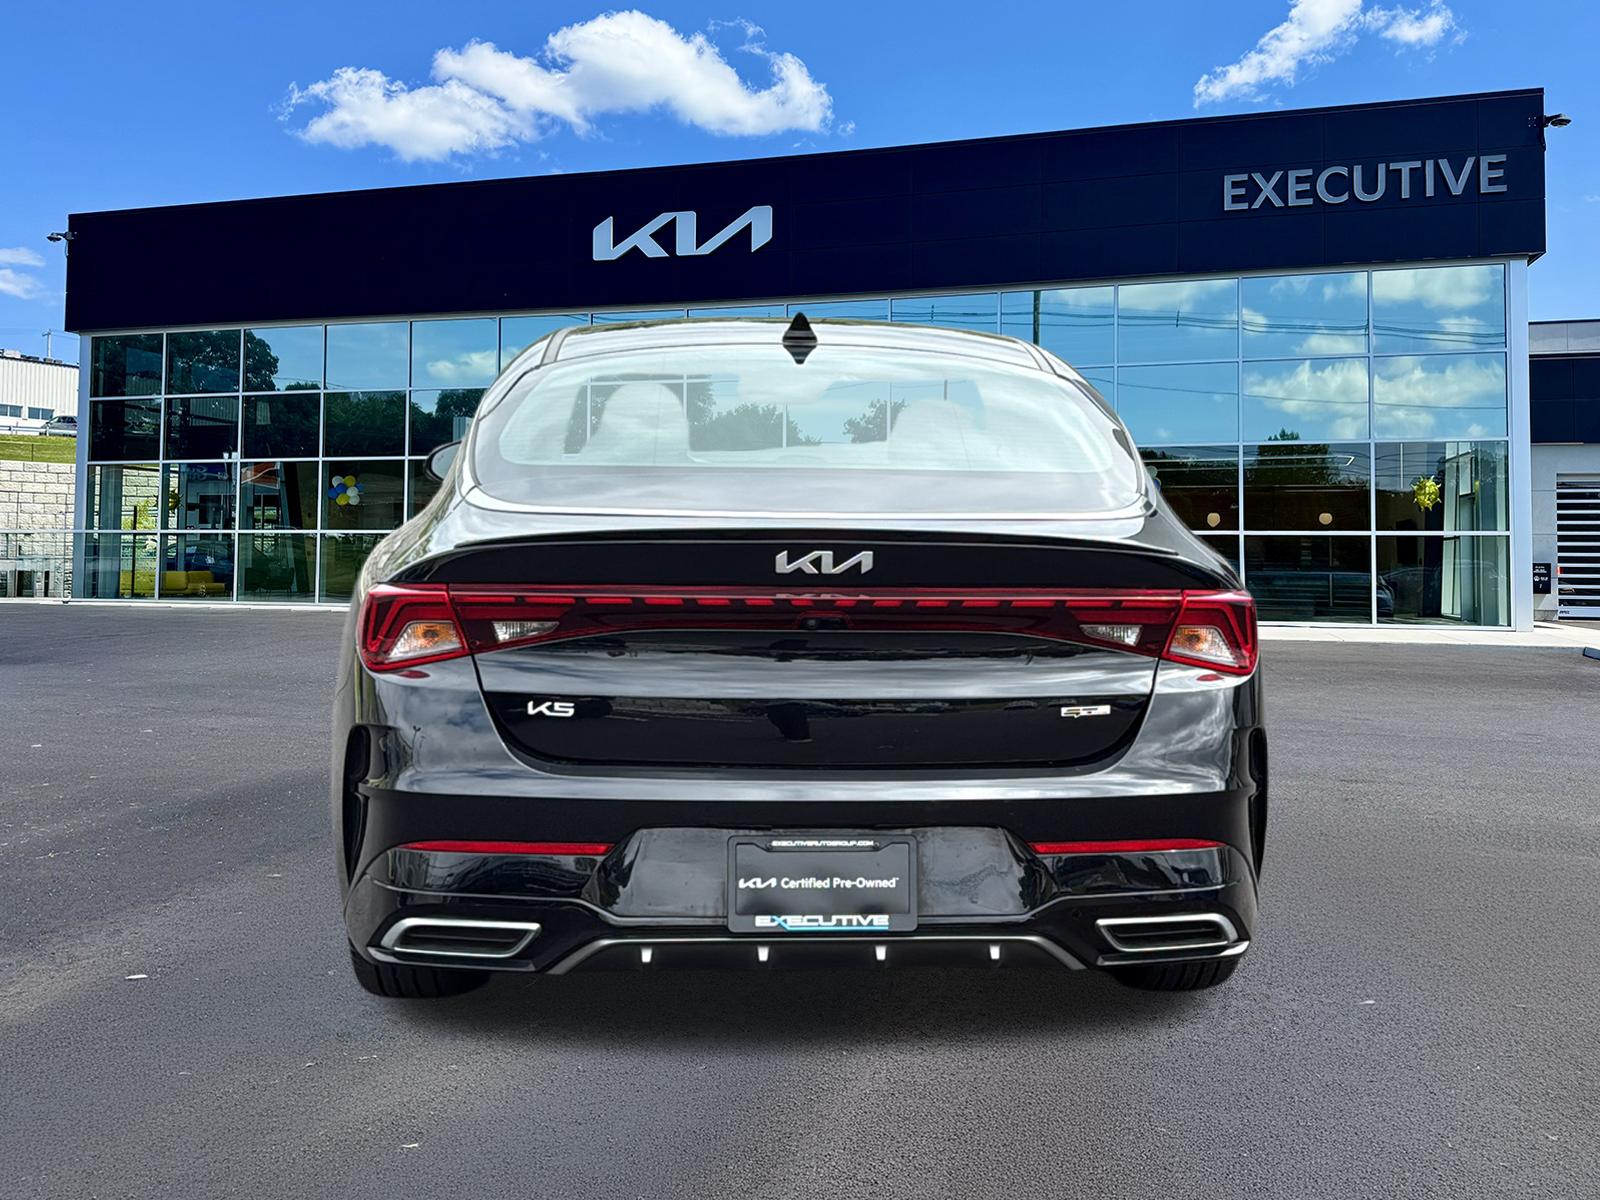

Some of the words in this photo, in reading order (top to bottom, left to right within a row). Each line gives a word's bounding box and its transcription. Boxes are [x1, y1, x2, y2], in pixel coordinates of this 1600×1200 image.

[1223, 154, 1508, 212] EXECUTIVE
[592, 205, 773, 262] KIA
[775, 550, 874, 575] KIA
[527, 700, 575, 717] K5
[738, 877, 777, 889] KIA
[780, 877, 830, 889] Certified
[755, 914, 889, 927] EXECUTIVE
